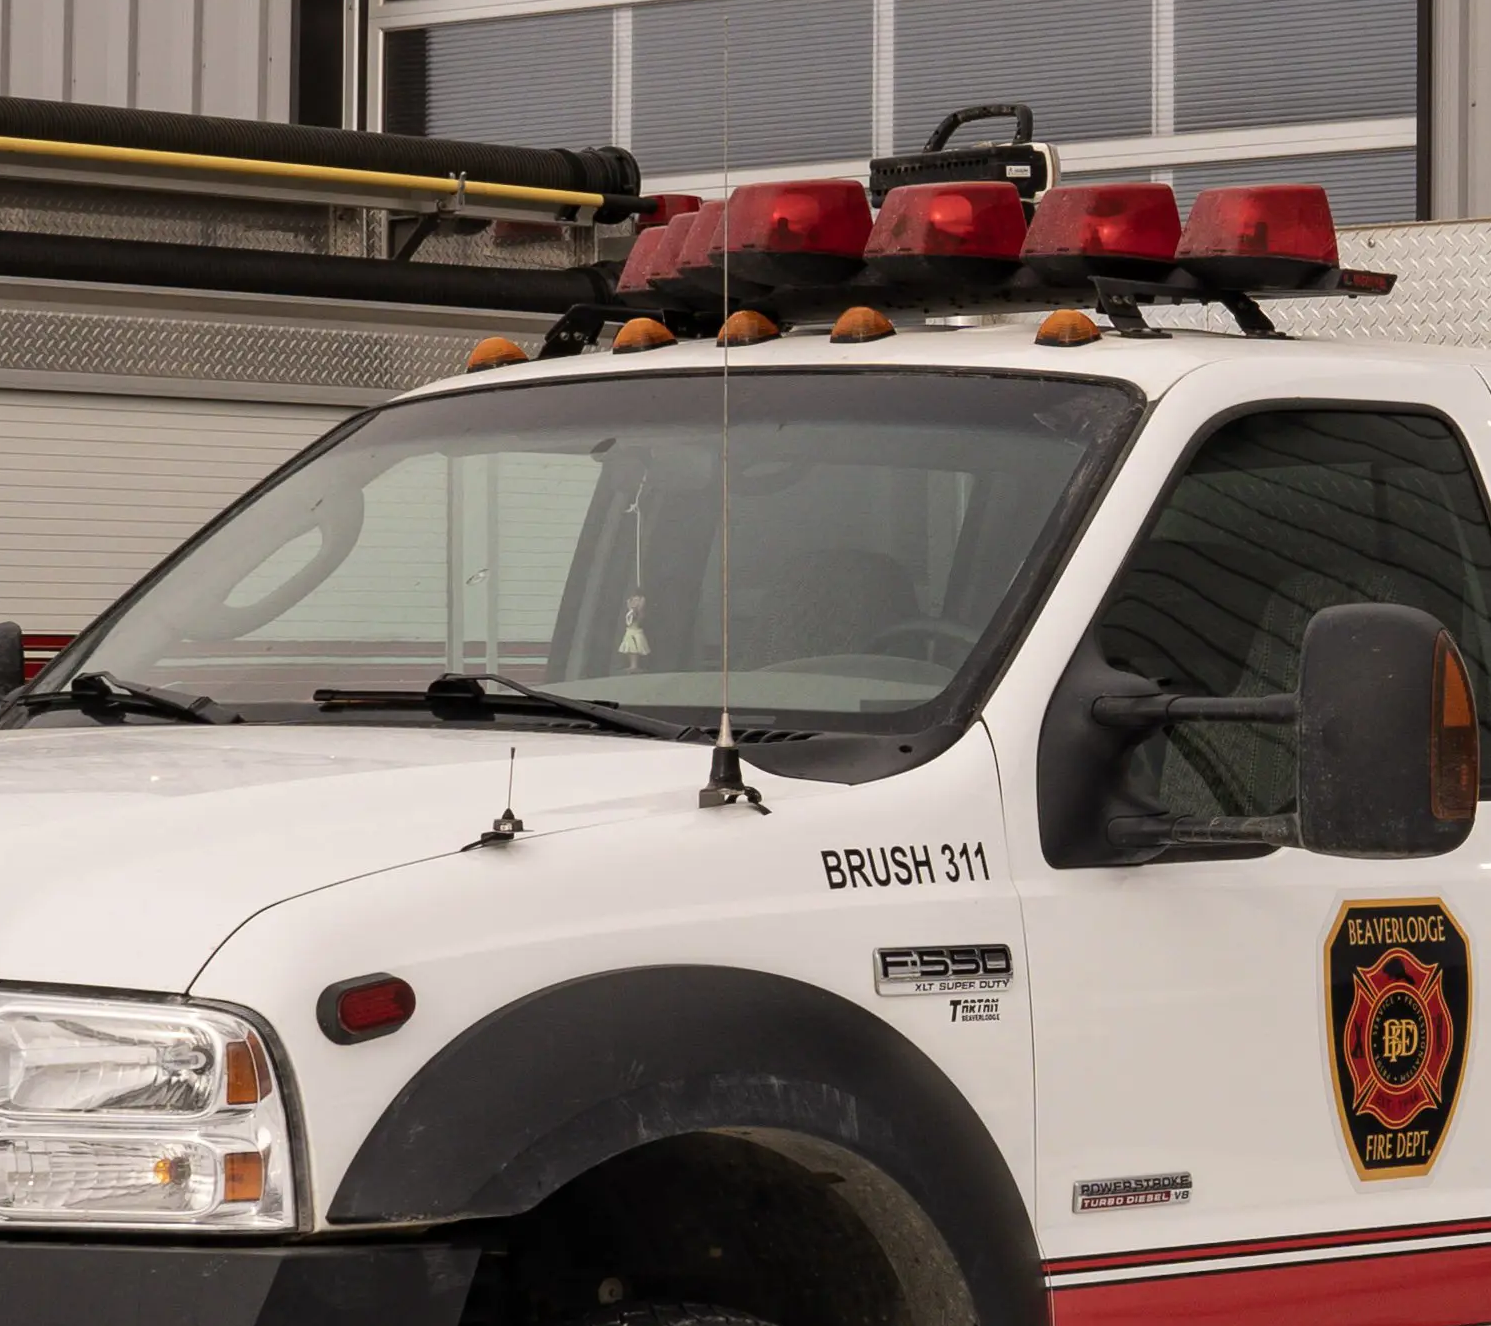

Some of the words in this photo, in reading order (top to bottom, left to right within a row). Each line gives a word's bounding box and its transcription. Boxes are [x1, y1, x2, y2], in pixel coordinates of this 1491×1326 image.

[821, 845, 936, 890] BRUSH
[941, 841, 990, 883] 311
[1347, 915, 1446, 945] BEAVERLODGE
[914, 983, 935, 992] XLT
[938, 981, 977, 991] SUPER
[979, 979, 1010, 989] DUTY
[1365, 1132, 1394, 1162] FIRE
[1395, 1130, 1432, 1159] DEPT.
[1083, 1196, 1125, 1209] TURBO
[1126, 1191, 1170, 1205] DIESEL
[1173, 1189, 1190, 1201] V8
